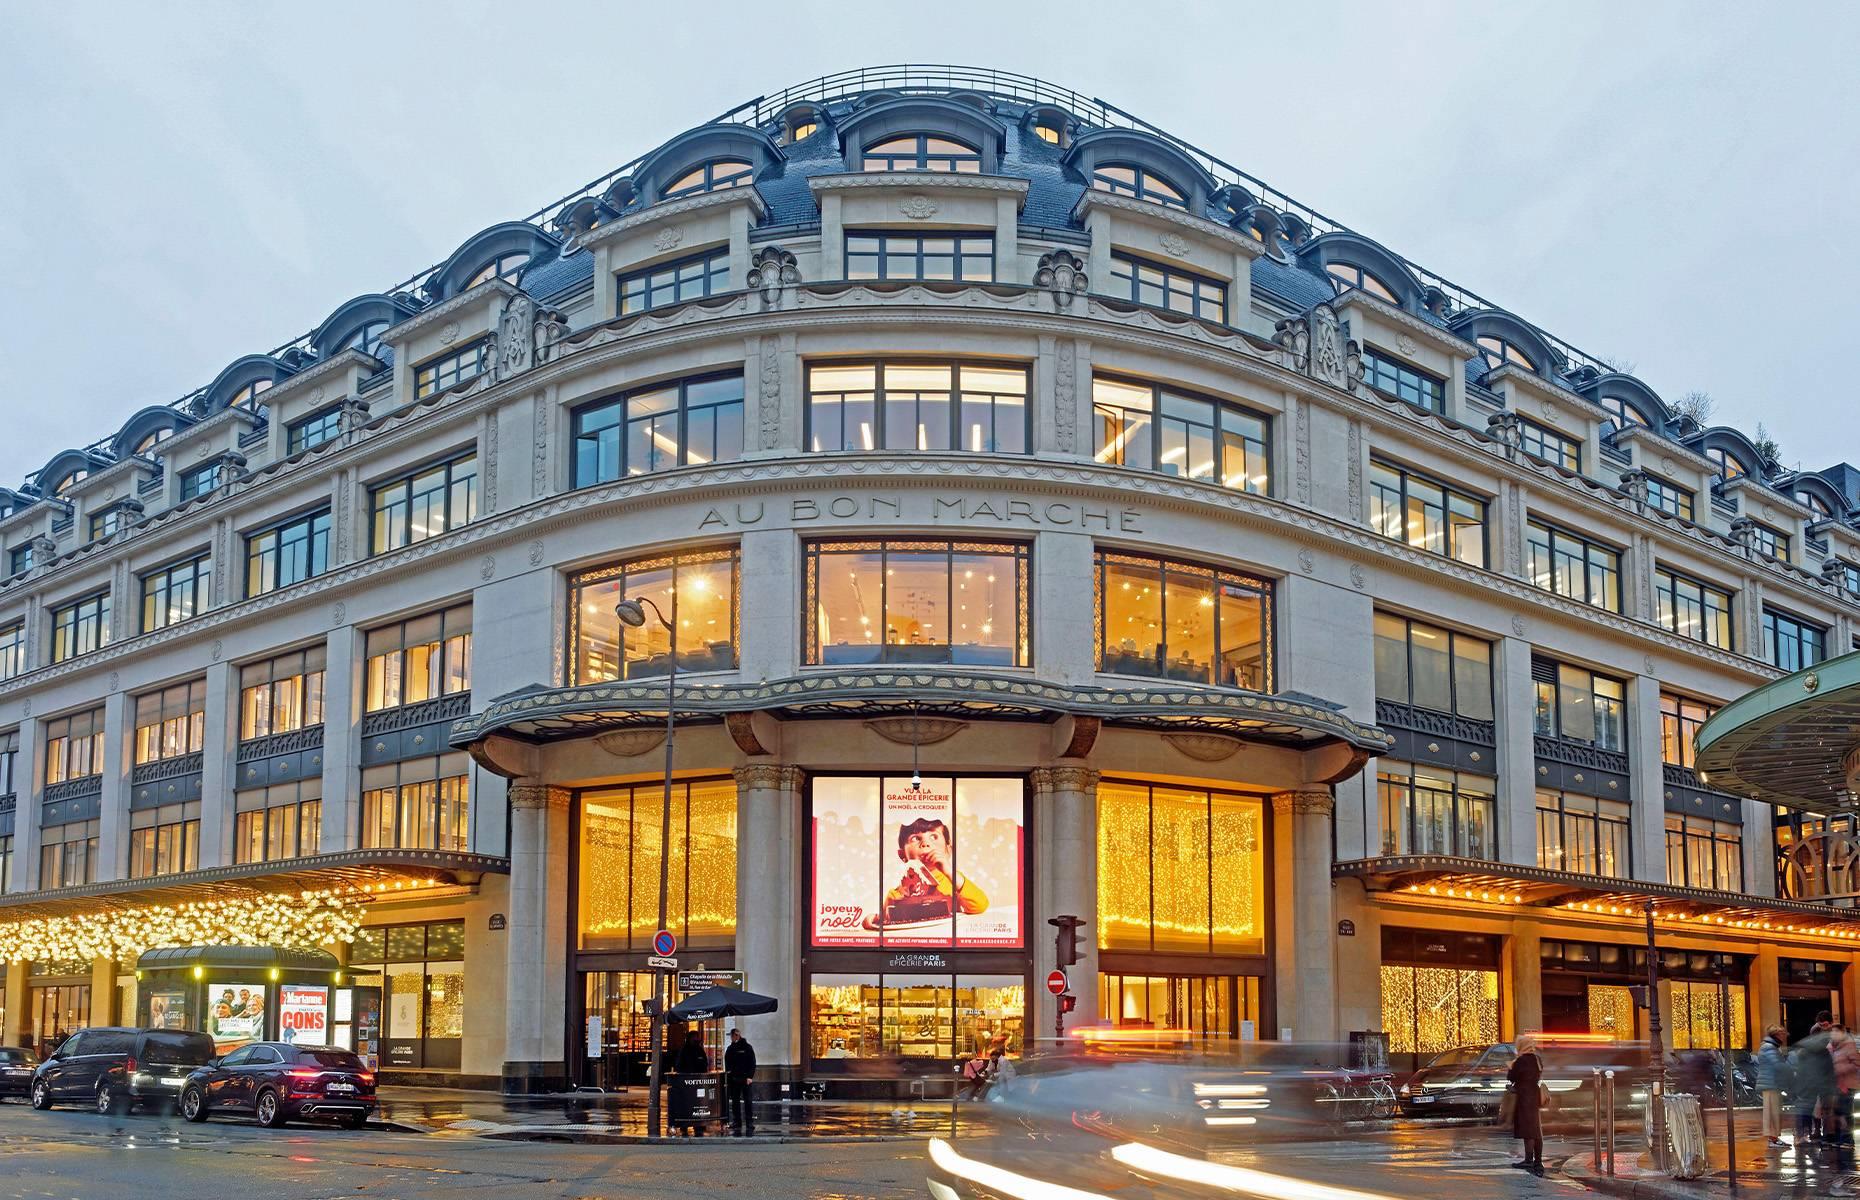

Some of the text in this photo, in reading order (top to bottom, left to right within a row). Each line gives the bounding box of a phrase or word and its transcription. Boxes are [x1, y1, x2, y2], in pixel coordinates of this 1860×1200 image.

[698, 496, 1144, 534] AU BON MARCHÉ
[820, 903, 861, 914] joyeux
[820, 907, 863, 928] noël
[285, 991, 322, 1004] Marianne
[282, 1011, 324, 1029] CONS
